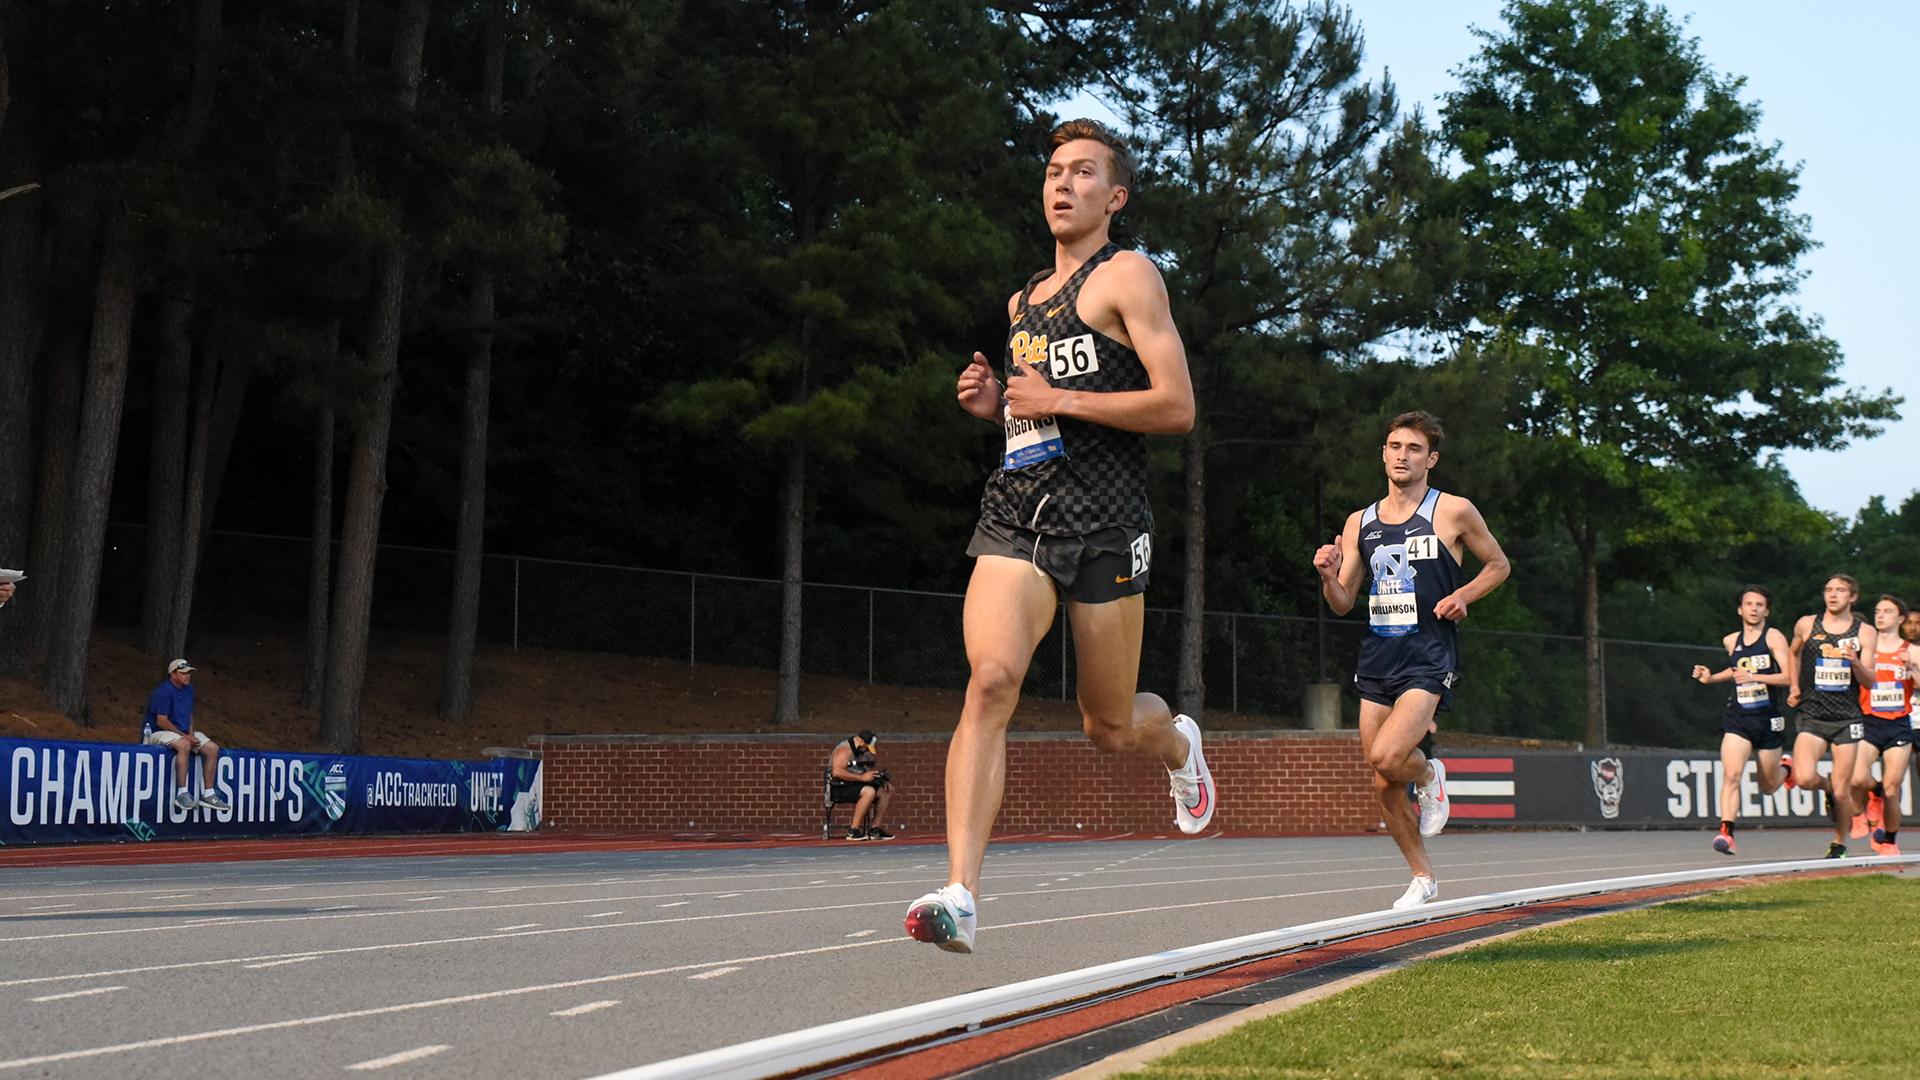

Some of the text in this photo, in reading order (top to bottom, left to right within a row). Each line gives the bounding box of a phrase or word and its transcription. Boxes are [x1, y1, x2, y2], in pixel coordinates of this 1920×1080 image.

[1010, 331, 1047, 366] Pitt
[1054, 338, 1089, 377] 56
[1365, 530, 1382, 540] ACC
[1408, 537, 1430, 558] 41
[1133, 535, 1149, 575] 56
[1370, 604, 1415, 615] WILLIAMSON
[328, 764, 345, 773] ACC
[10, 747, 304, 825] CHAMPIONSHIPS
